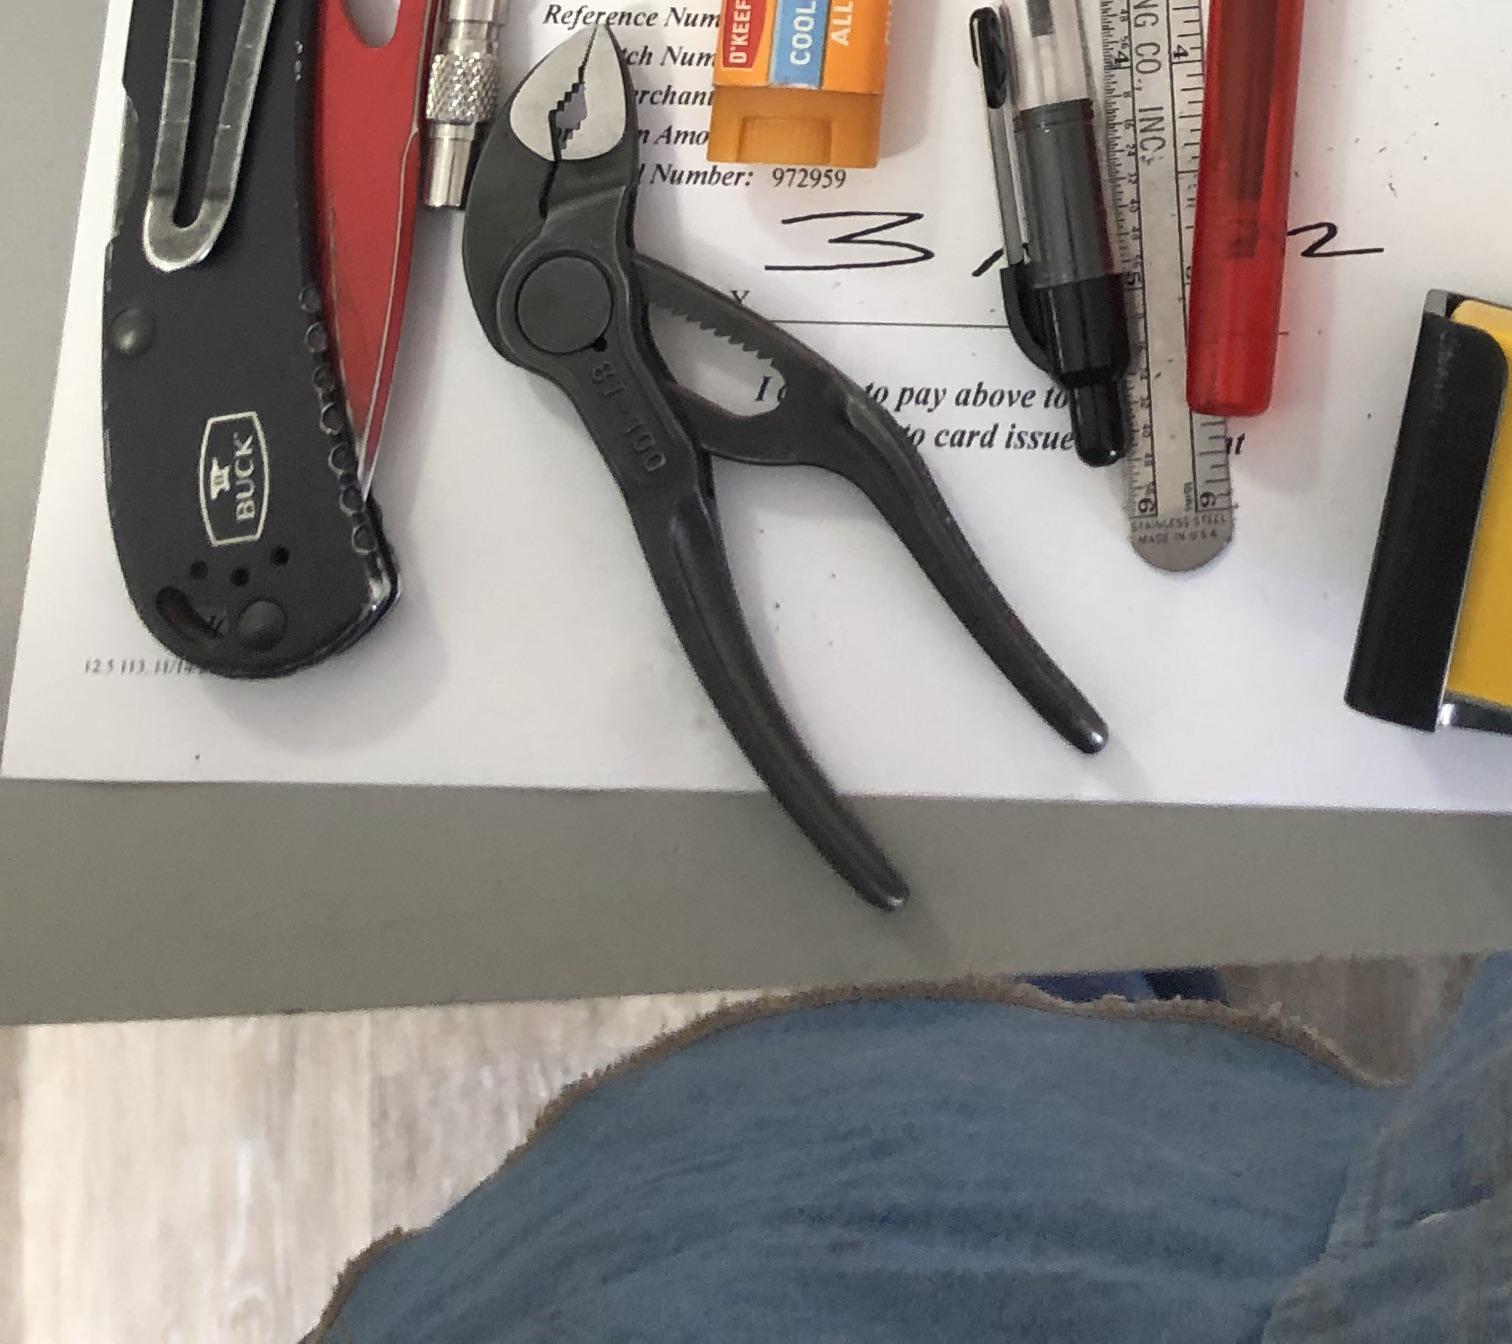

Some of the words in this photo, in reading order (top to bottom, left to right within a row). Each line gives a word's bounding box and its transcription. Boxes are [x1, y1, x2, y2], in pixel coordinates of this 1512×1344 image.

[542, 4, 658, 28] Reference
[830, 0, 855, 47] ALL
[650, 165, 753, 189] Number:
[771, 168, 848, 189] 972959
[895, 385, 947, 413] pay
[954, 382, 1035, 409] above
[933, 424, 996, 449] card
[234, 431, 258, 522] BUCK
